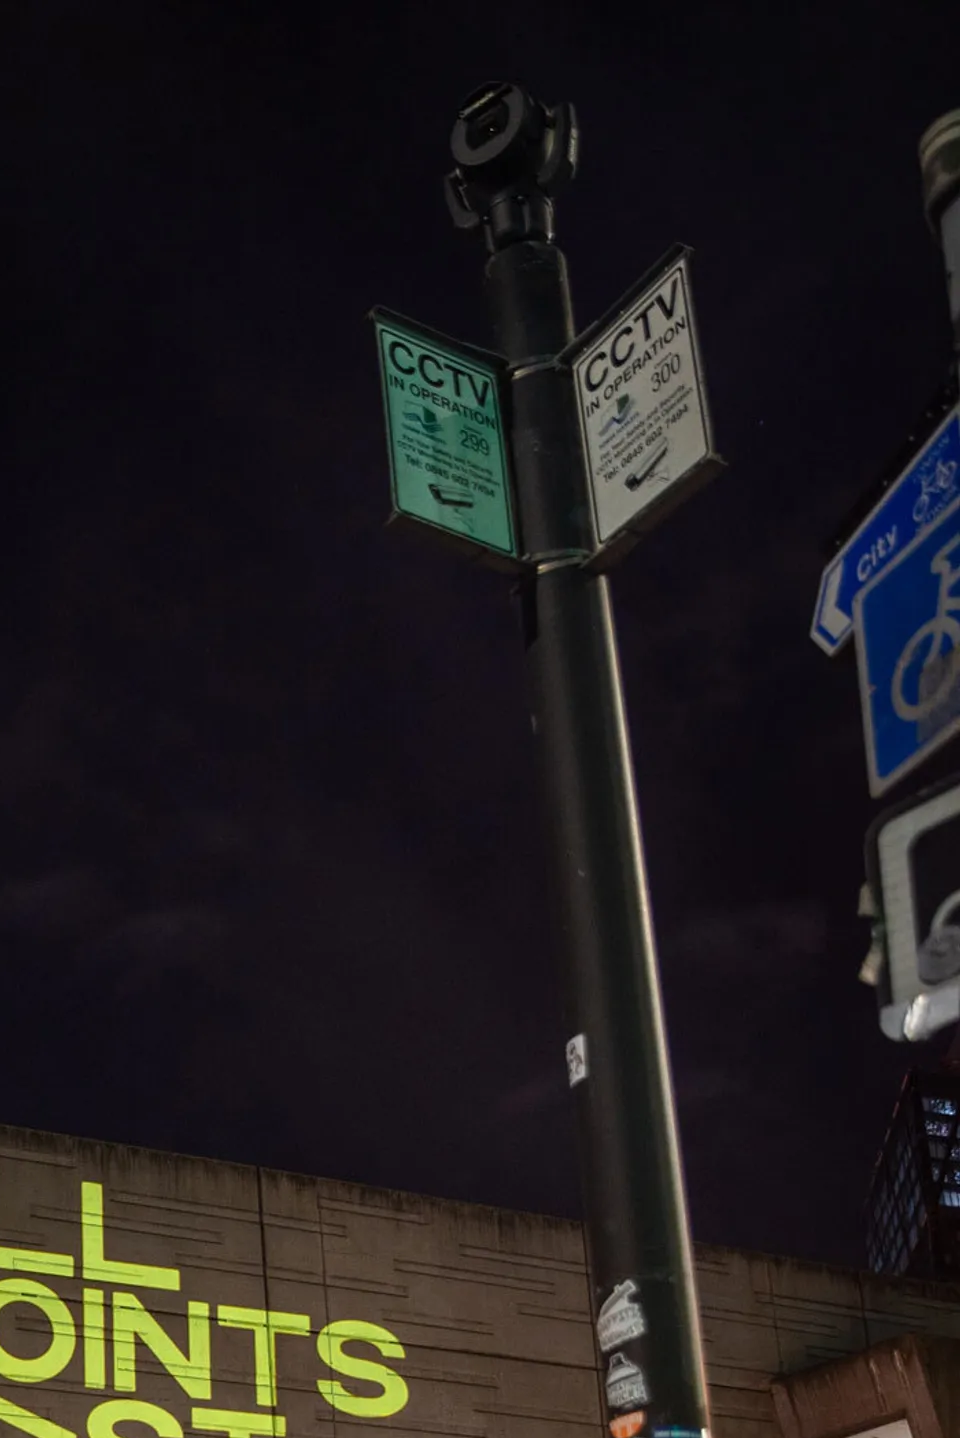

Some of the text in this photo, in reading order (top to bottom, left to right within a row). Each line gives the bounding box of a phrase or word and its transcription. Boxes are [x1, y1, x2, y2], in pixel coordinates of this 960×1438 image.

[584, 277, 679, 392] CCTV
[388, 340, 490, 408] CCTV
[585, 316, 688, 419] IN OPERATION
[651, 353, 682, 393] 300
[389, 374, 497, 430] IN OPERATION
[459, 430, 489, 457] 299
[857, 525, 897, 582] City
